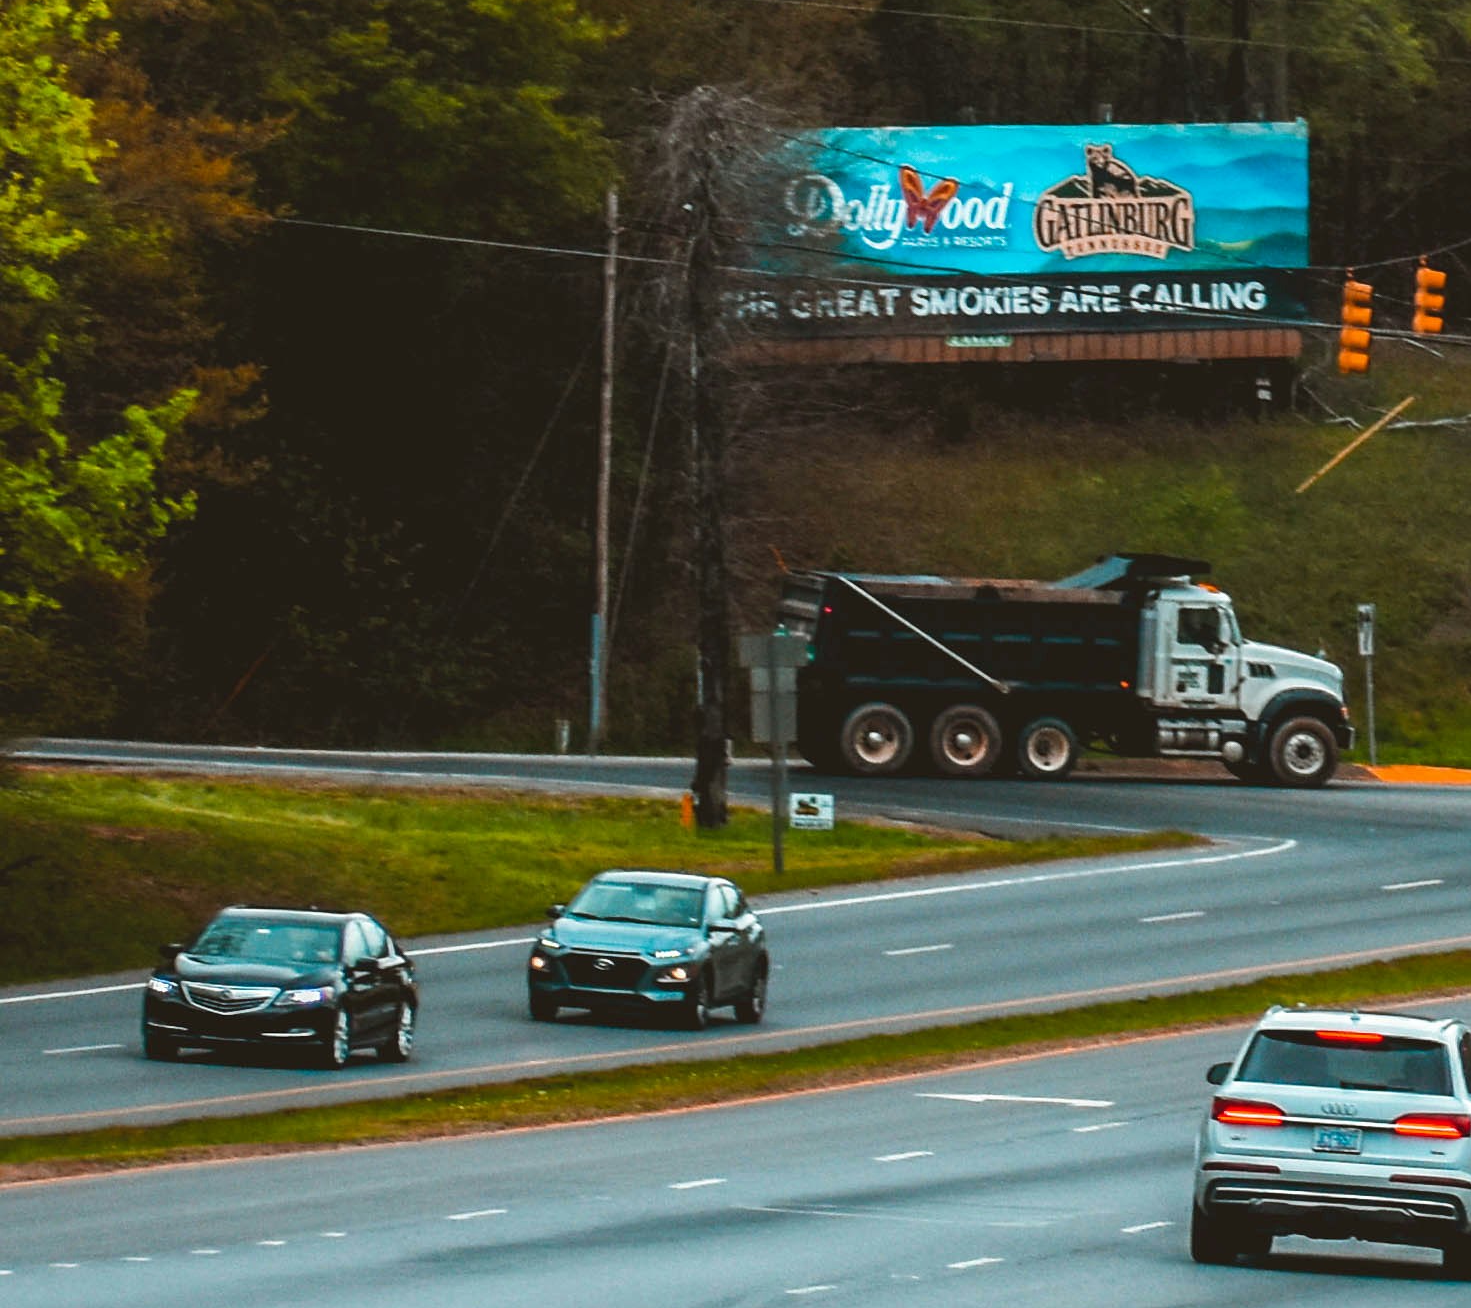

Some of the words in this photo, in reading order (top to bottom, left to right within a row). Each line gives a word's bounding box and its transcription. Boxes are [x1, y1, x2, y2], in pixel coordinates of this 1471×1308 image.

[1036, 198, 1191, 248] GATLINBURG
[911, 285, 1051, 317] SMOKIES
[1058, 284, 1121, 313] ARE
[1129, 281, 1268, 313] CALLING
